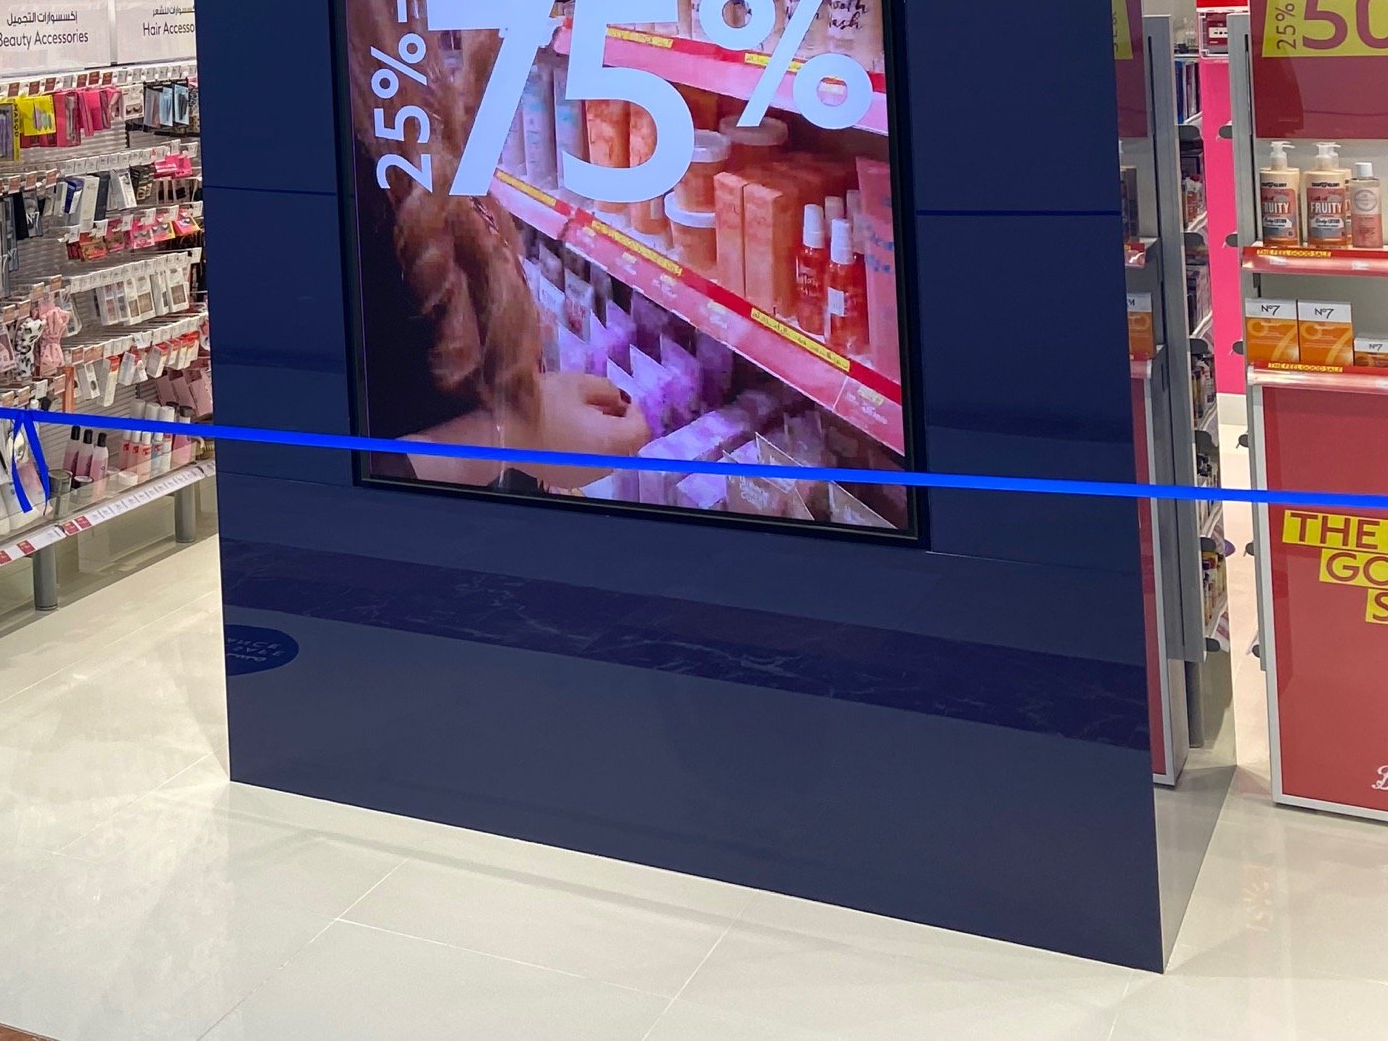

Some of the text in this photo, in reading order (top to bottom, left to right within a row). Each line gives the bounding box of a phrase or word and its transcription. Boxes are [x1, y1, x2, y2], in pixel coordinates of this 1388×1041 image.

[142, 21, 195, 36] Hair Accesso
[33, 29, 89, 46] Accessories
[1311, 202, 1343, 214] FRUITY
[1288, 512, 1380, 550] THE
[1325, 551, 1388, 587] GO
